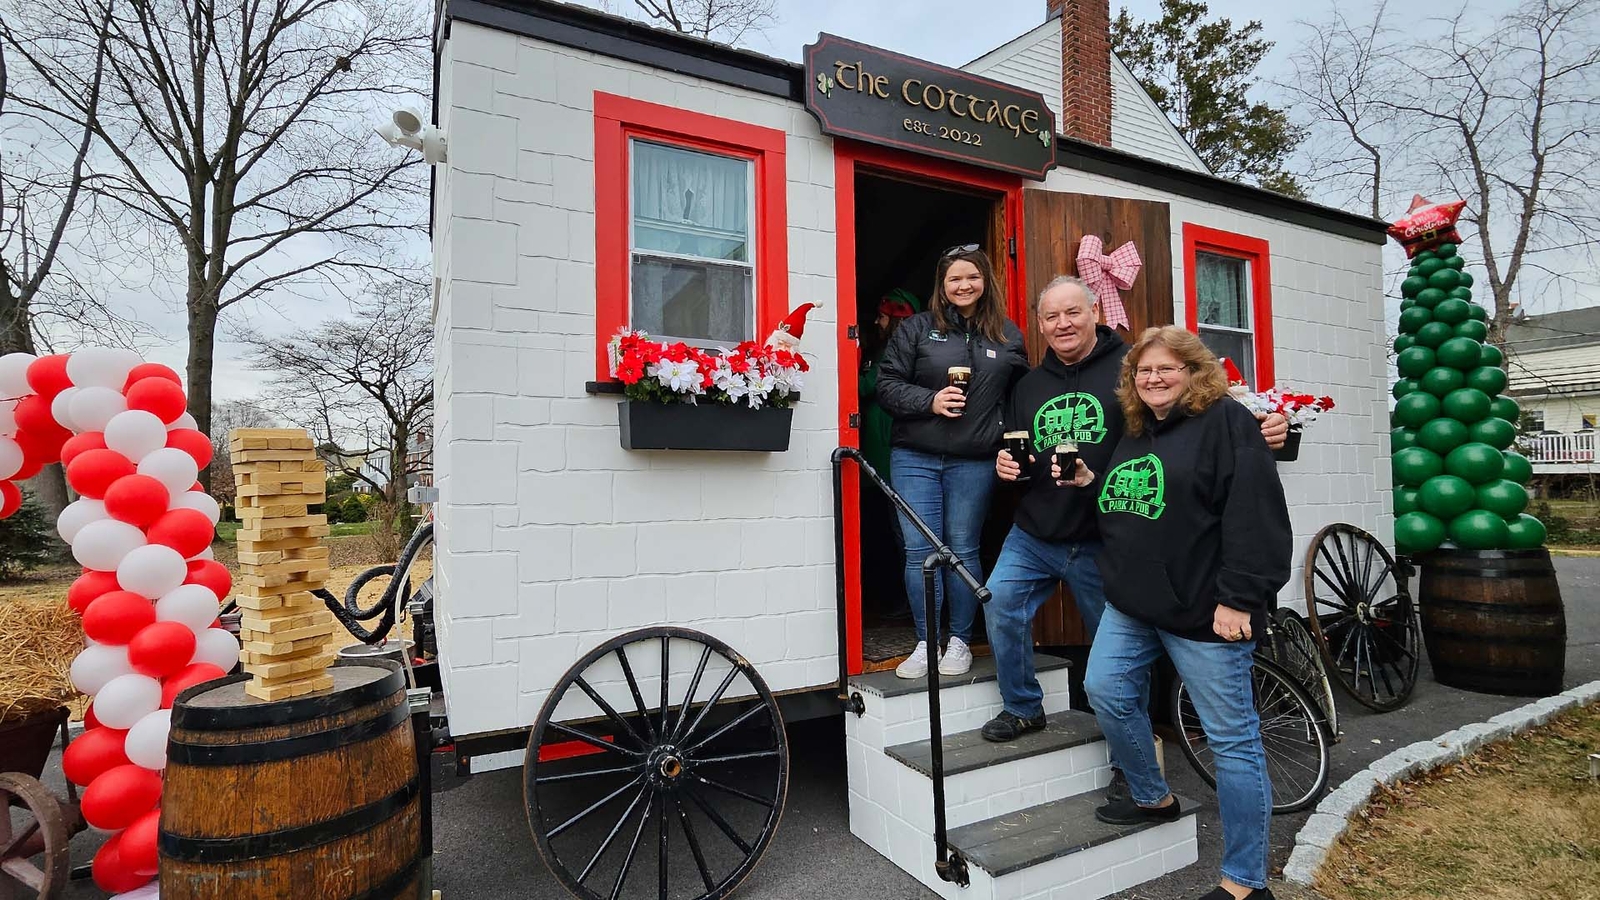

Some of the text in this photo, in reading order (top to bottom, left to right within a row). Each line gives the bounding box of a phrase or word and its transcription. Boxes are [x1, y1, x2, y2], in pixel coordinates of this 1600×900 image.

[834, 60, 890, 98] The
[939, 126, 982, 147] 2022
[1405, 217, 1450, 237] Christmas
[1043, 433, 1063, 448] PARK
[1074, 431, 1092, 441] PUB
[1108, 500, 1150, 515] PARK A PUB
